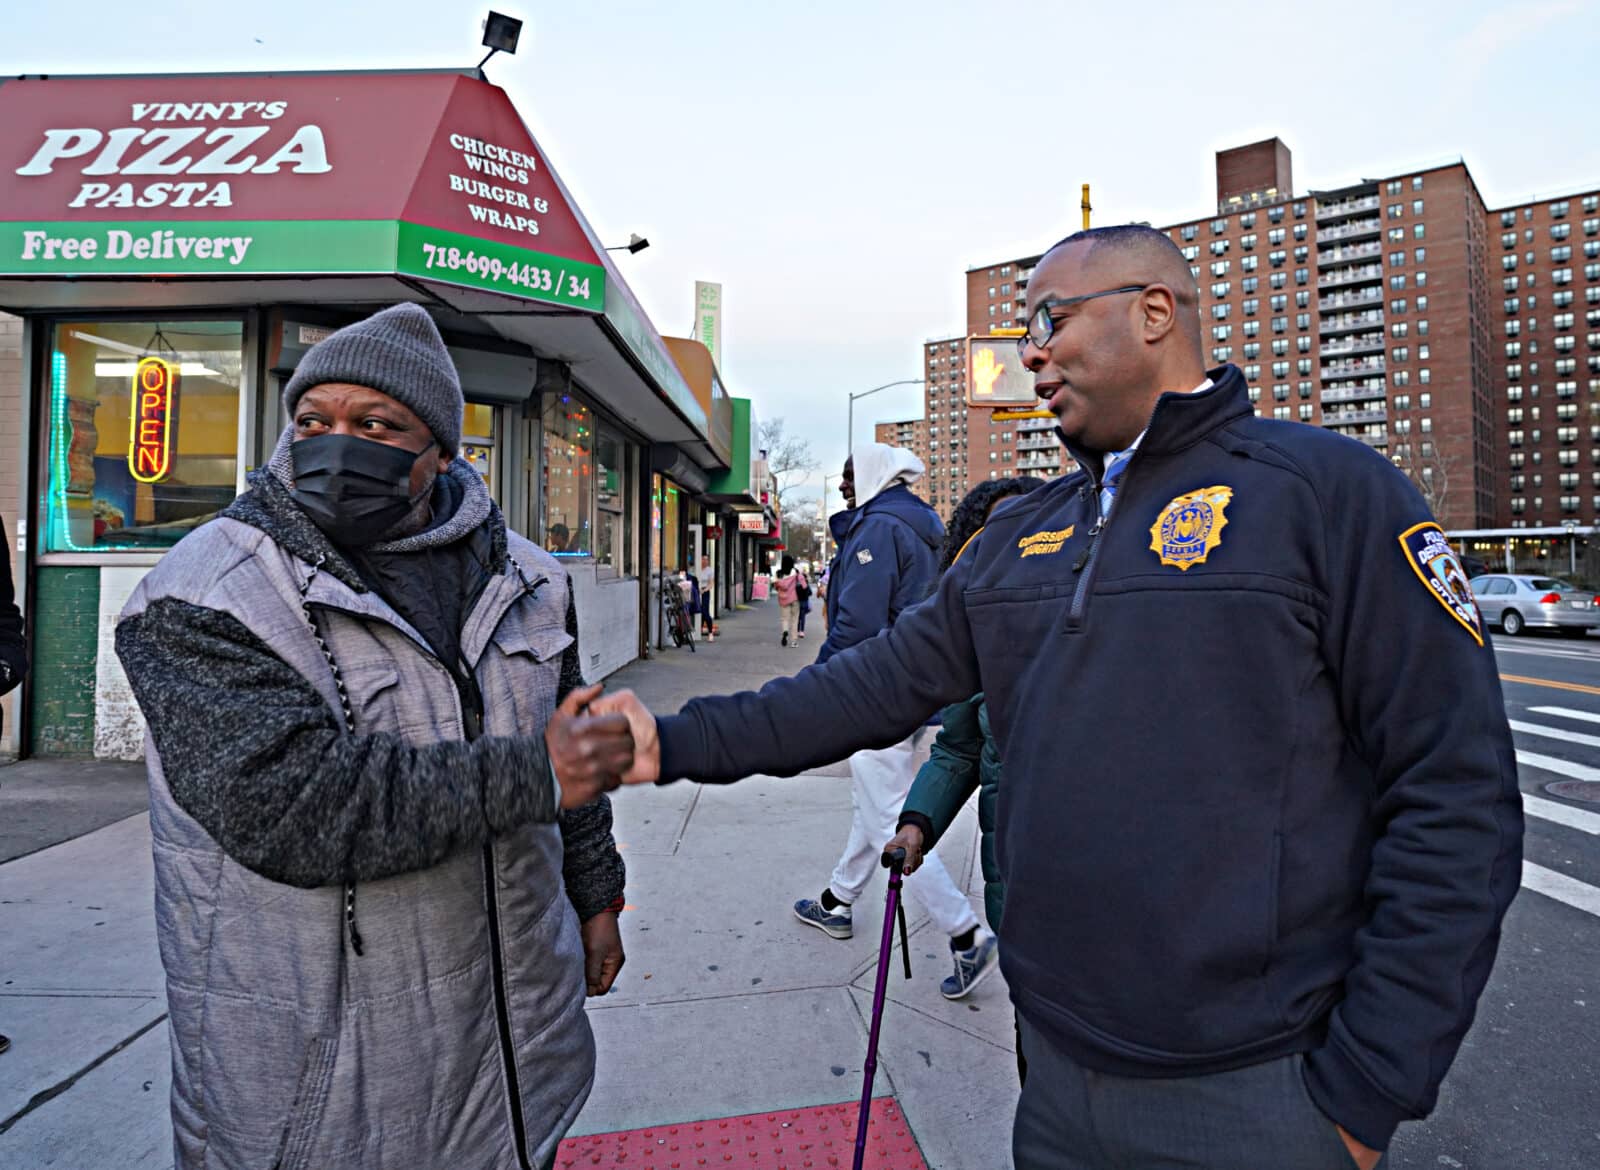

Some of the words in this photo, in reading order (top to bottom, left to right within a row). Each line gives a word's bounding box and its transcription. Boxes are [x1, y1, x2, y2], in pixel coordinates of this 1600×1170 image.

[131, 101, 288, 122] VINNY'S
[15, 124, 333, 176] PIZZA
[450, 133, 536, 171] CHICKEN
[463, 154, 529, 184] WINGS
[67, 181, 233, 208] PASTA
[449, 174, 531, 210] BURGER
[533, 197, 549, 214] &
[468, 204, 539, 235] WRAPS
[20, 230, 98, 260] Free
[104, 230, 253, 265] Delivery
[423, 243, 552, 291] 718-699-4433
[568, 275, 591, 300] 34
[138, 365, 164, 472] OPEN
